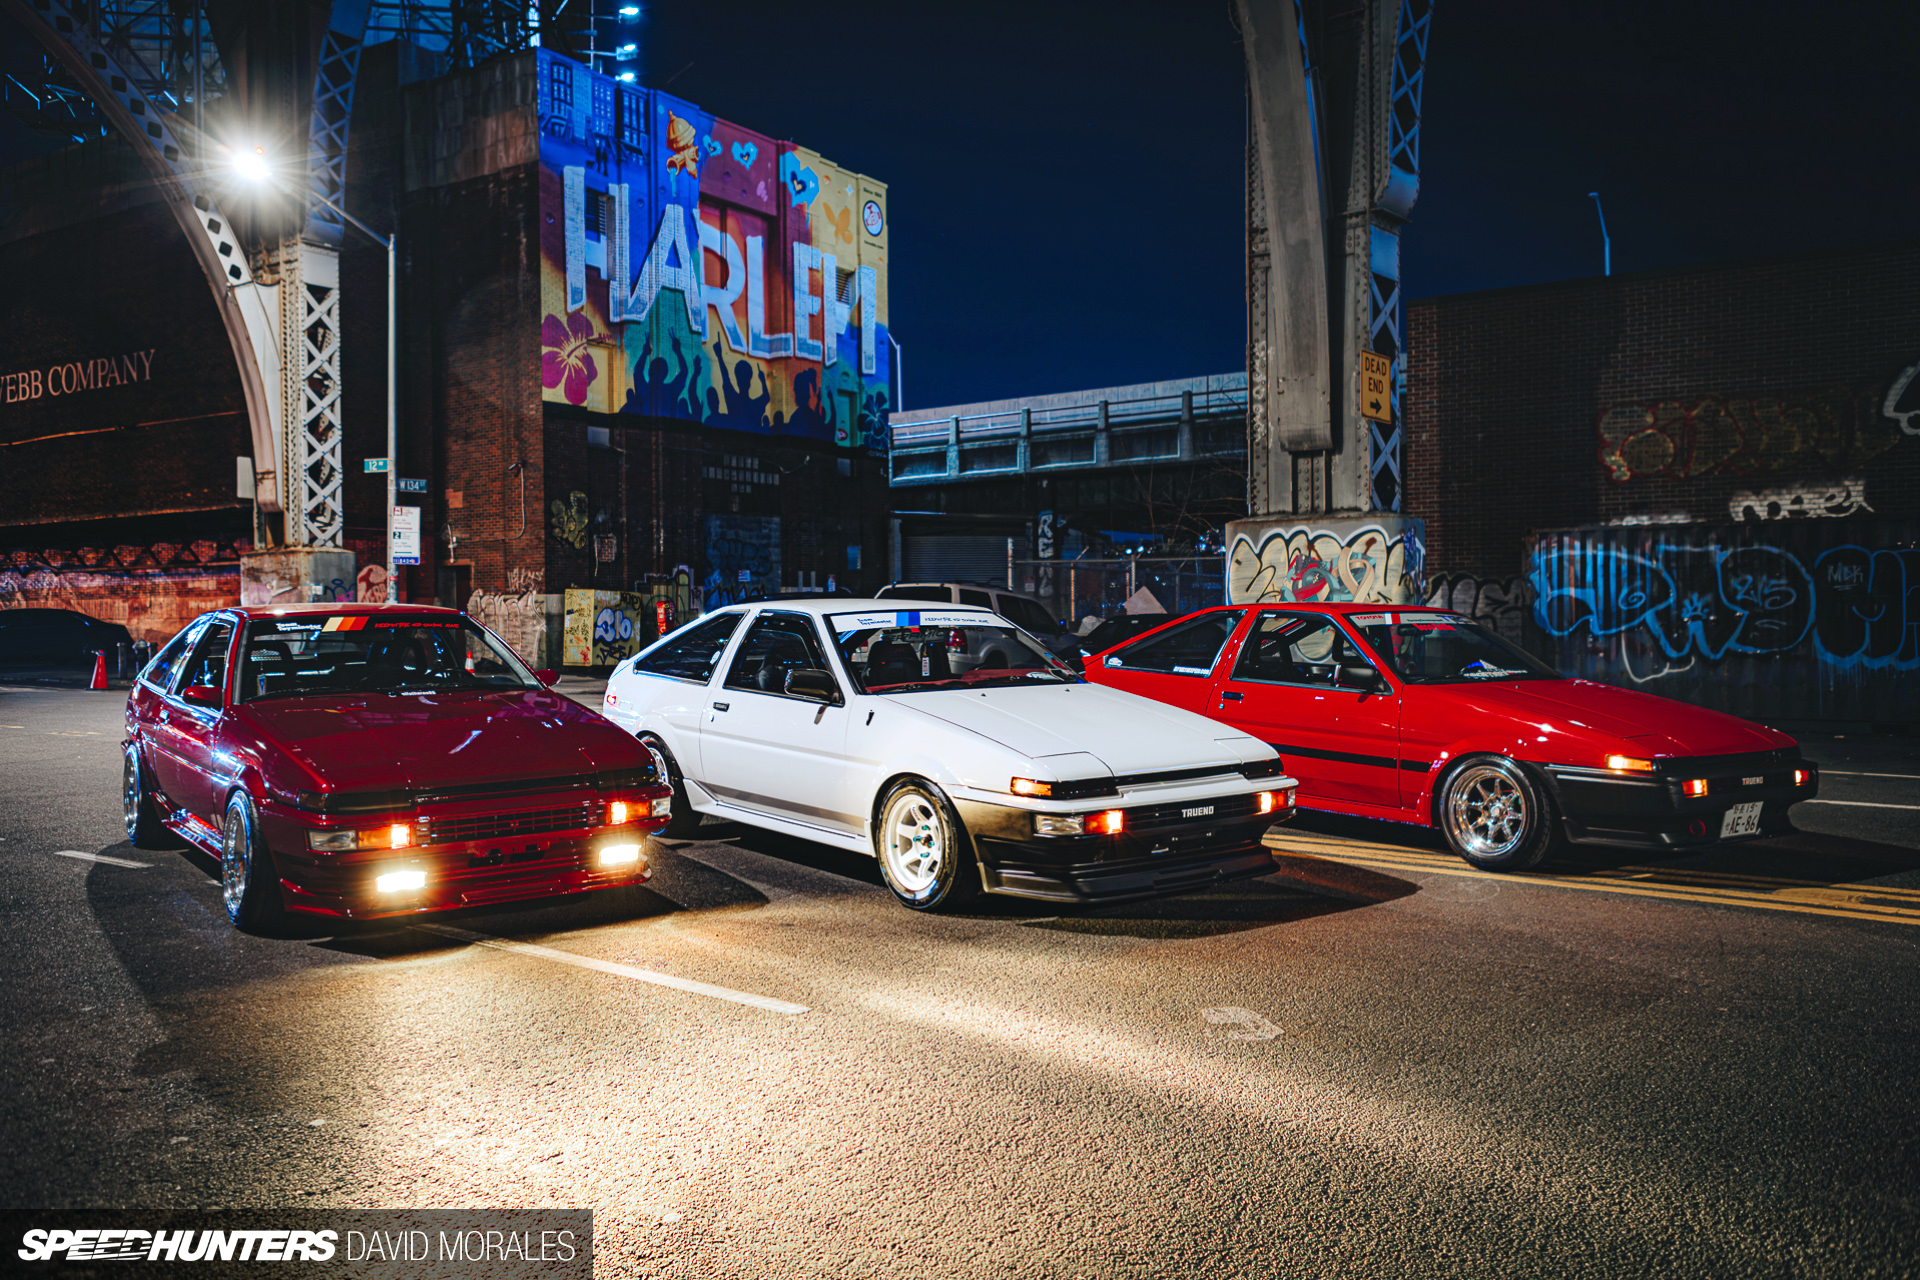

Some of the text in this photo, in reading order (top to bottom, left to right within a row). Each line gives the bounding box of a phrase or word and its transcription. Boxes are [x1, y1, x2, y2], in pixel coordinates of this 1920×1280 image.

[563, 166, 876, 375] HARLEM
[48, 349, 155, 396] COMPANY
[1365, 356, 1387, 376] DEAD
[1368, 377, 1384, 394] END
[368, 461, 378, 471] 12
[400, 481, 406, 489] W
[407, 481, 420, 490] 134
[1742, 777, 1763, 786] TRUENO
[1181, 805, 1214, 818] TRUENO
[1729, 815, 1757, 834] AE-86
